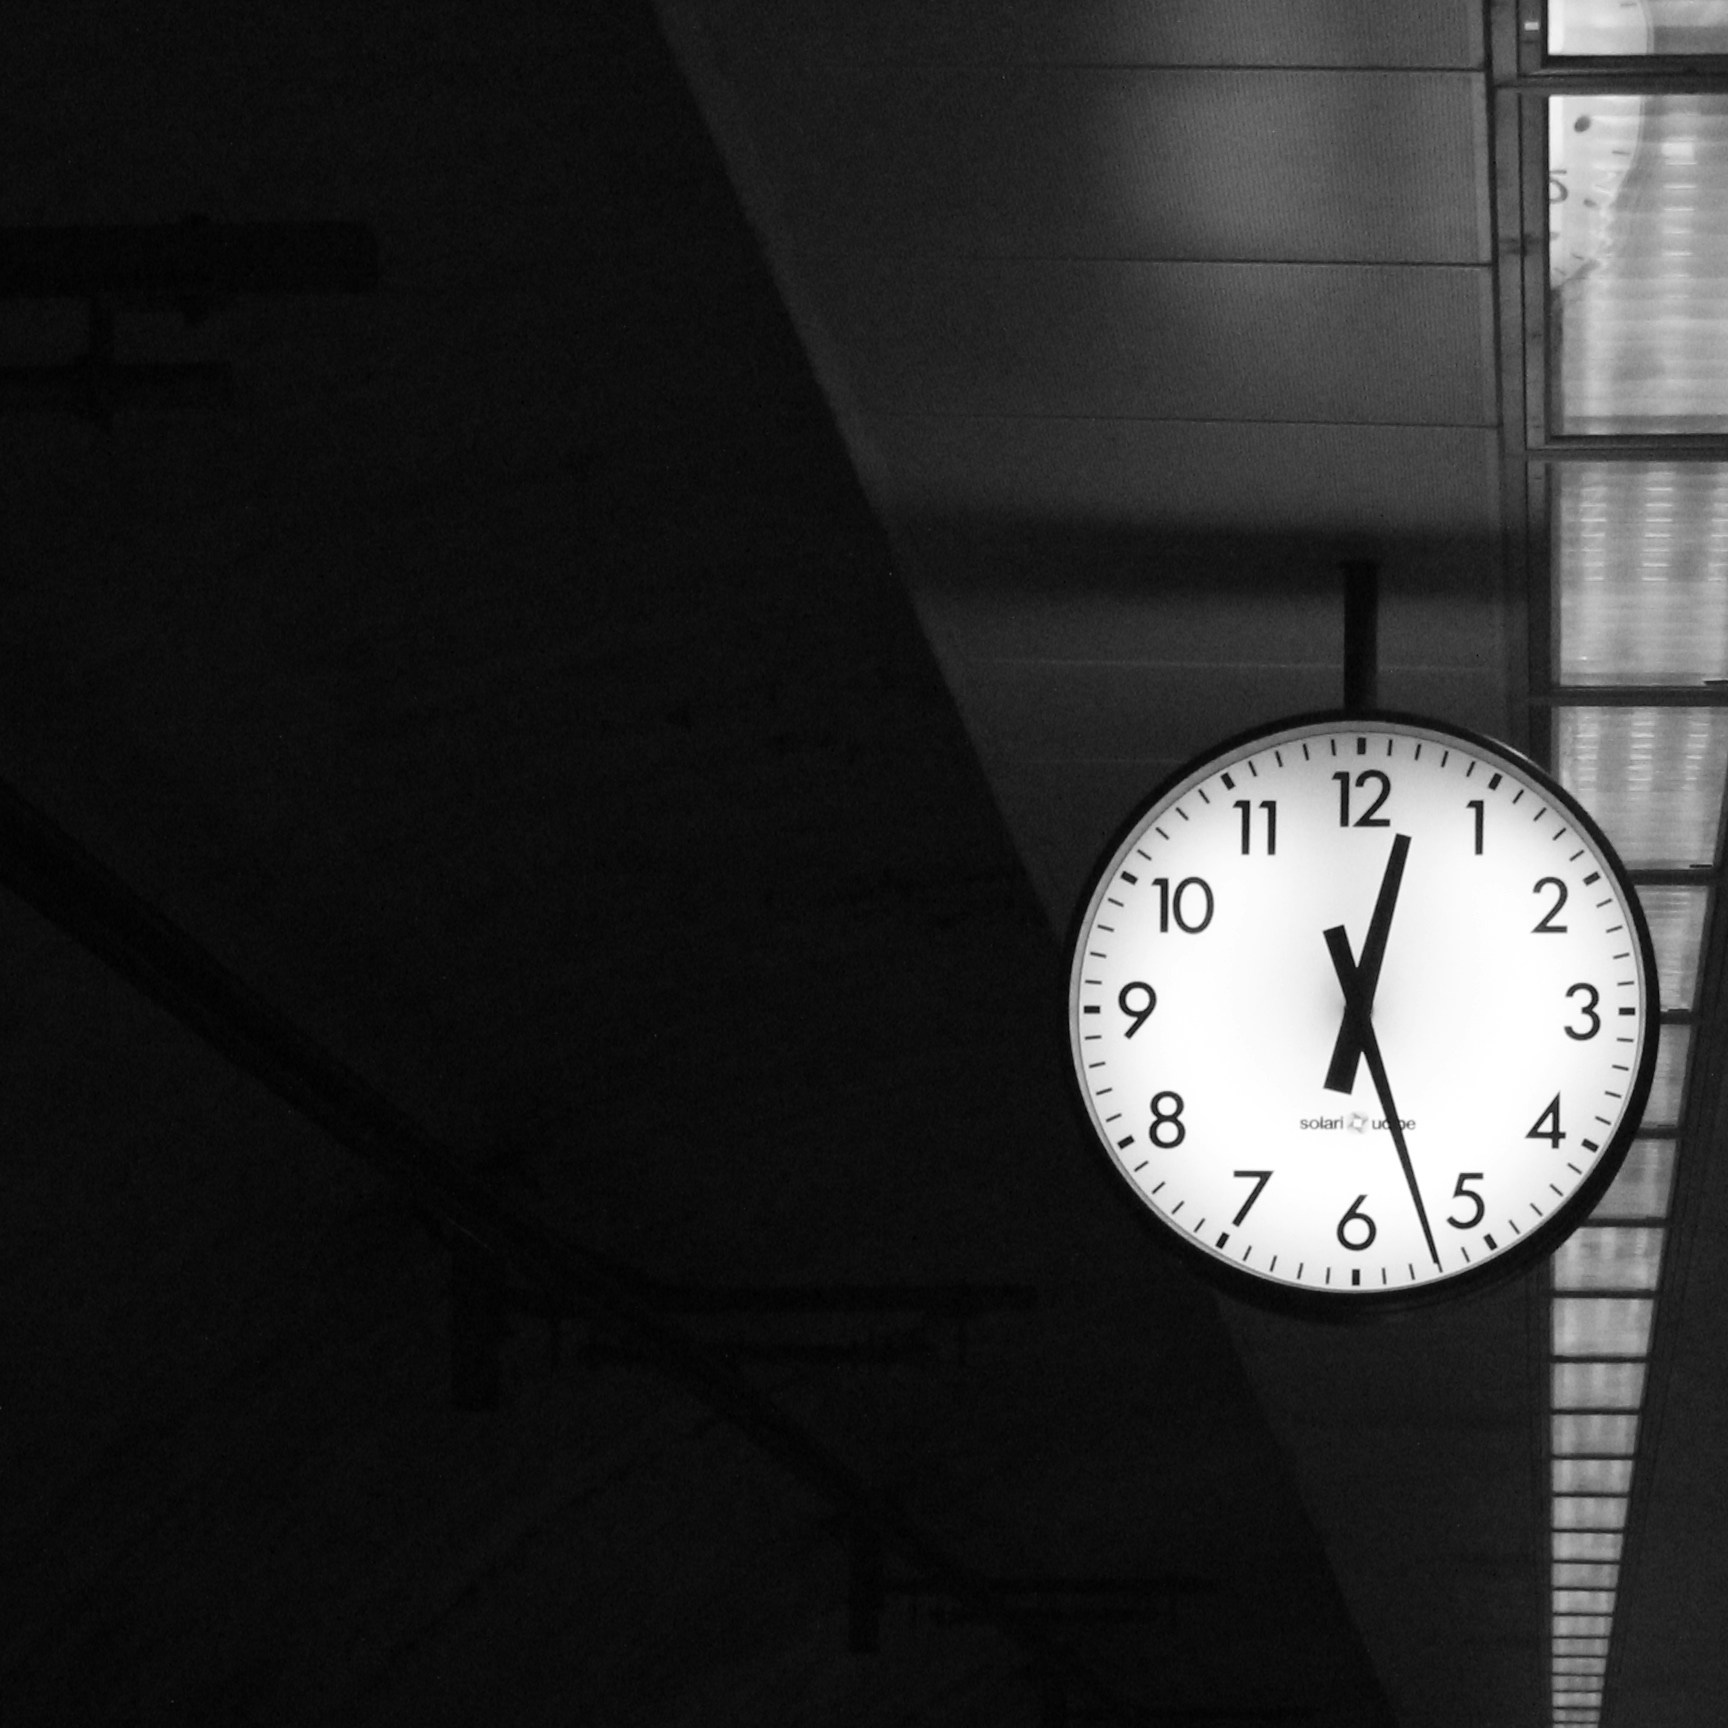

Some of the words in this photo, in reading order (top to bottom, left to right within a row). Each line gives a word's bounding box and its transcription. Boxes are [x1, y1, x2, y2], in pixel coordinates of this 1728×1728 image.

[1331, 769, 1391, 827] 12
[1233, 800, 1276, 855] 11
[1467, 800, 1484, 855] 1
[1152, 877, 1214, 934] 10
[1533, 877, 1568, 933] 2
[1118, 982, 1156, 1039] 9
[1565, 983, 1600, 1040] 3
[1149, 1091, 1185, 1149] 8
[1299, 1115, 1345, 1131] solari
[1526, 1093, 1566, 1148] 4
[1232, 1171, 1272, 1227] 7
[1337, 1195, 1376, 1251] 6
[1447, 1173, 1484, 1229] 5
